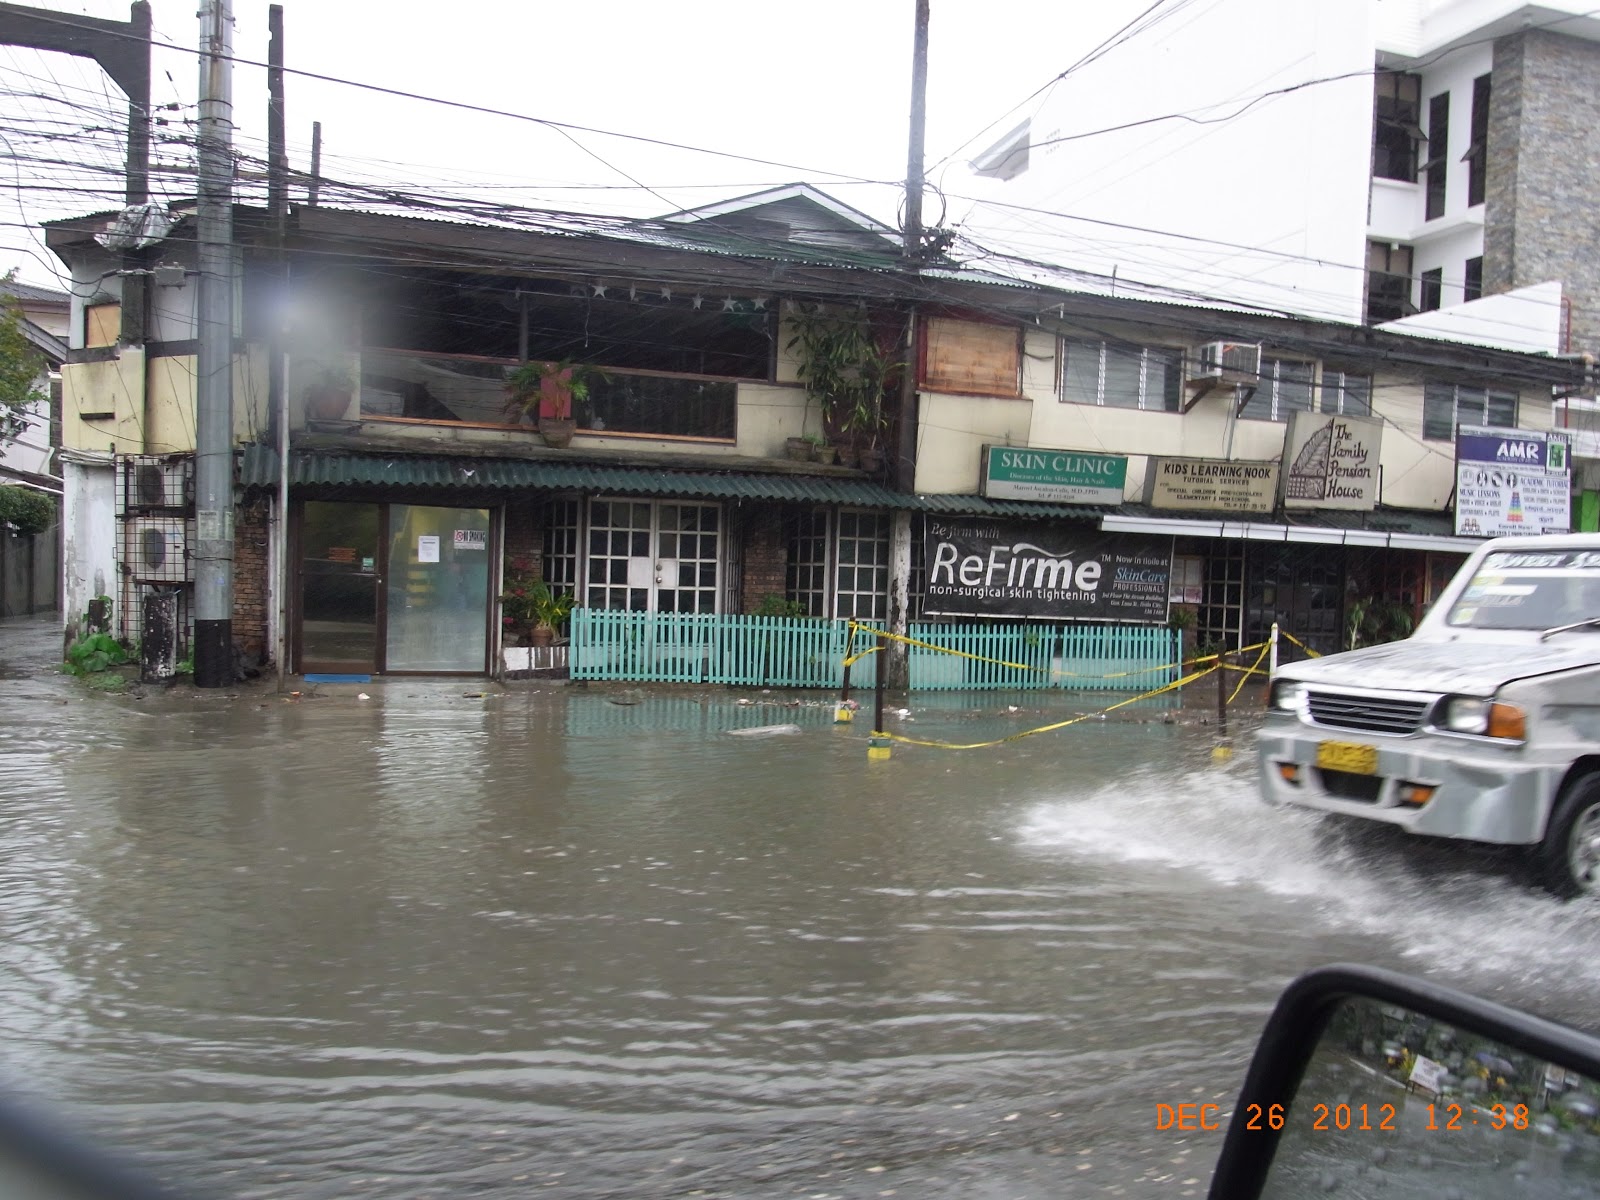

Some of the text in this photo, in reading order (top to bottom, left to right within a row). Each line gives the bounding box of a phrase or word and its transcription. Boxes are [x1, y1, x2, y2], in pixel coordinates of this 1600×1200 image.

[1335, 424, 1352, 440] The
[1496, 441, 1538, 459] AMR
[1002, 452, 1116, 476] SKIN CLINIC
[1164, 464, 1271, 479] KIDS LEARNING NOOK
[1328, 460, 1371, 478] Pension
[1184, 476, 1250, 486] TUTORIAL SERVICES
[1326, 479, 1363, 498] House
[1478, 490, 1500, 498] LESSONS
[932, 523, 1000, 539] Be firm with
[930, 542, 1111, 591] ReFirme TM
[1116, 555, 1132, 563] Now
[1115, 567, 1166, 582] SkinCare
[930, 585, 1096, 604] non-surgical skin tightening
[1113, 582, 1164, 594] PROFESSIONALS
